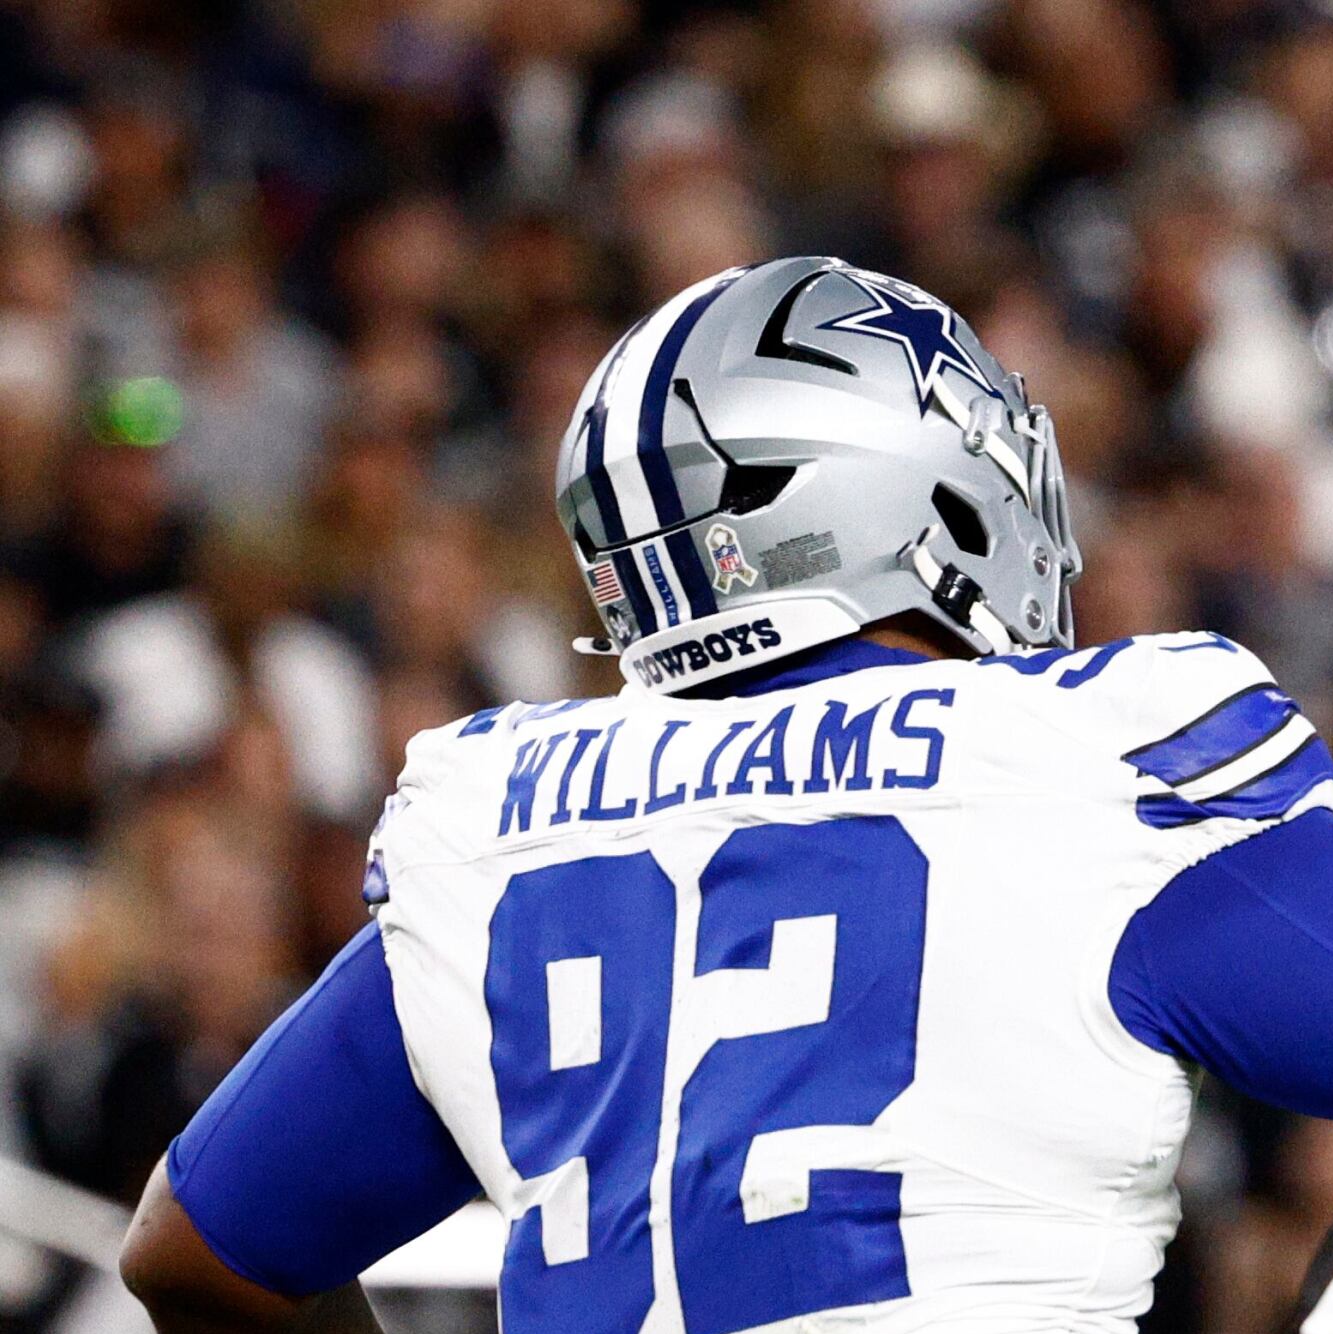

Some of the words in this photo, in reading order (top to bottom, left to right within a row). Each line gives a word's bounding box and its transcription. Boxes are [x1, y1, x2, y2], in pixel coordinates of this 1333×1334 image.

[718, 556, 741, 571] NFL
[633, 617, 781, 688] COWBOYS
[497, 689, 956, 837] WILLIAMS
